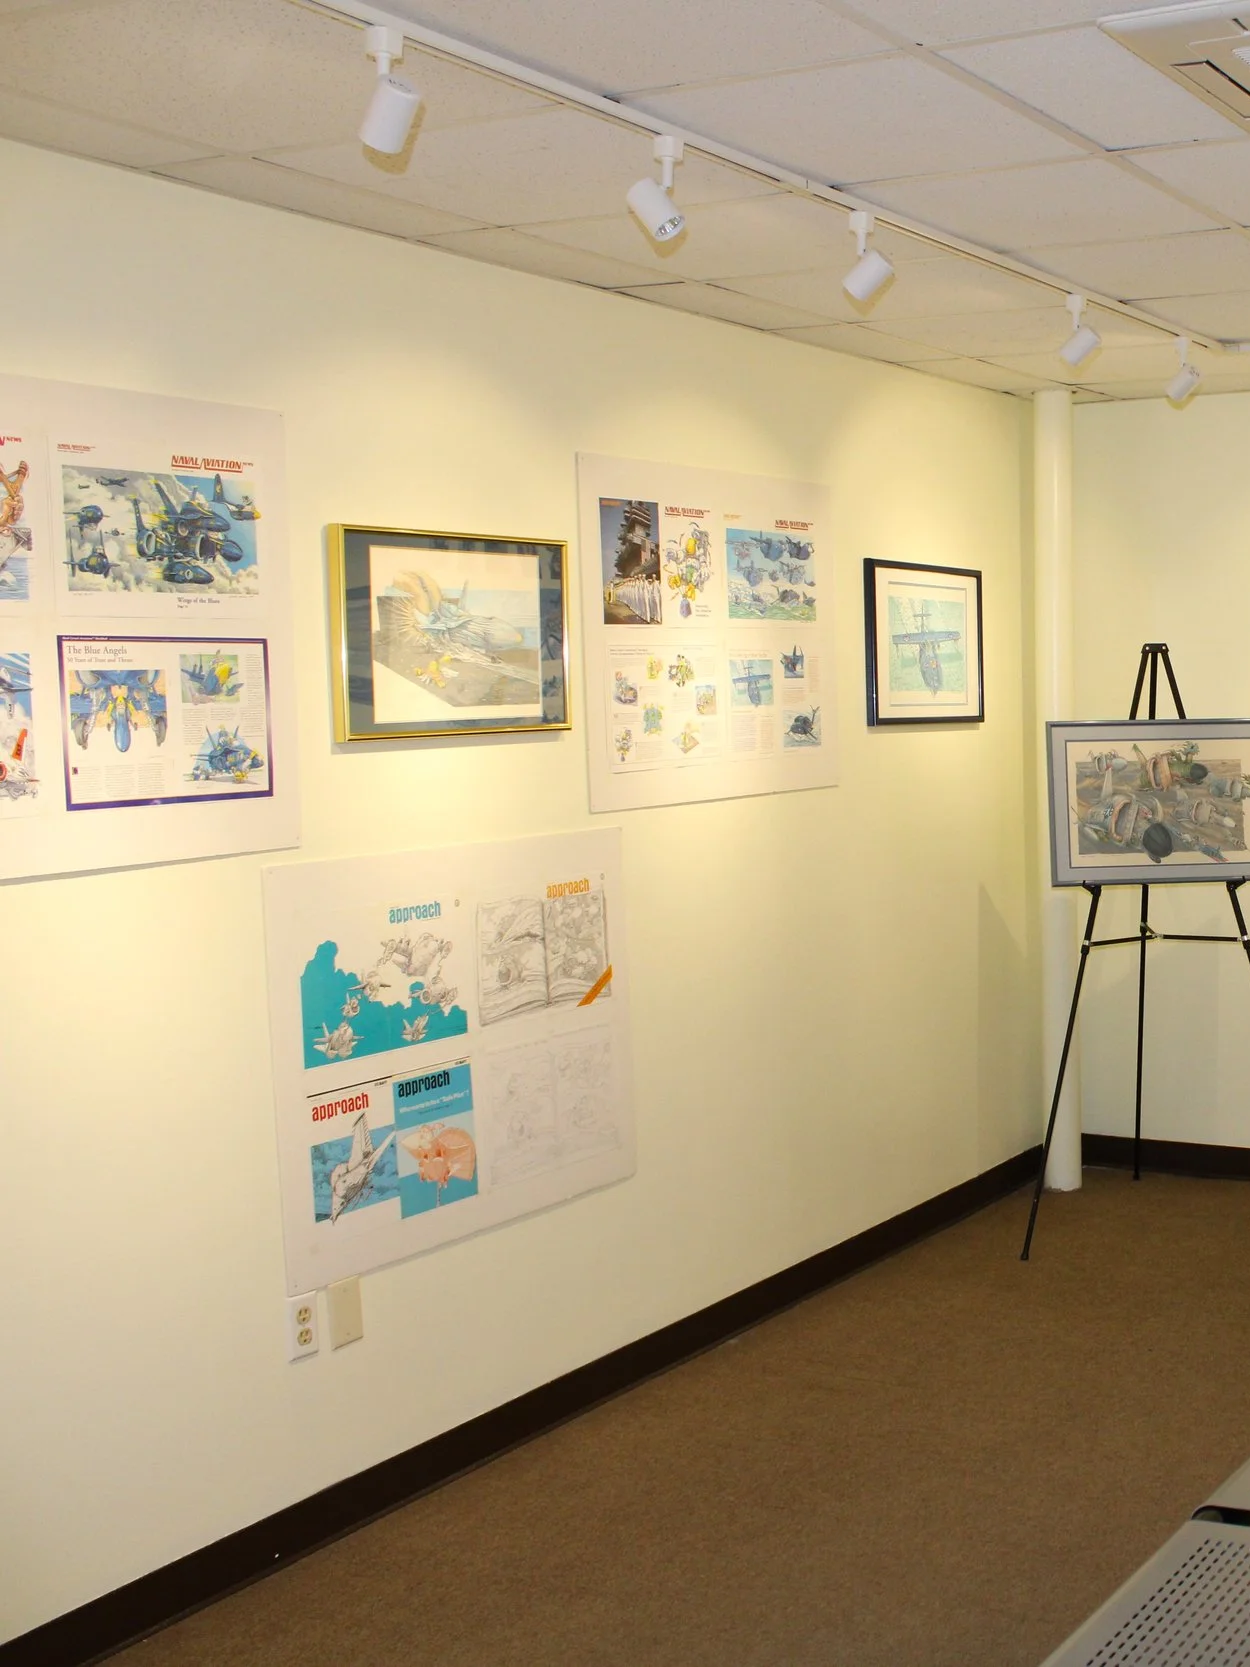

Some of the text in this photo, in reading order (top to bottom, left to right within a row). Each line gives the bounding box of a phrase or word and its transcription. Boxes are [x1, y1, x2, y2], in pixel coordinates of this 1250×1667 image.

[171, 455, 200, 467] NAVAL
[201, 458, 242, 471] AVIATION
[665, 506, 704, 517] NAVAL AVIATION
[775, 519, 789, 527] NAVAL
[66, 645, 127, 656] The Blue Angels
[546, 878, 589, 899] approach
[389, 900, 441, 924] approach
[398, 1070, 450, 1098] approach
[312, 1092, 369, 1122] approach
